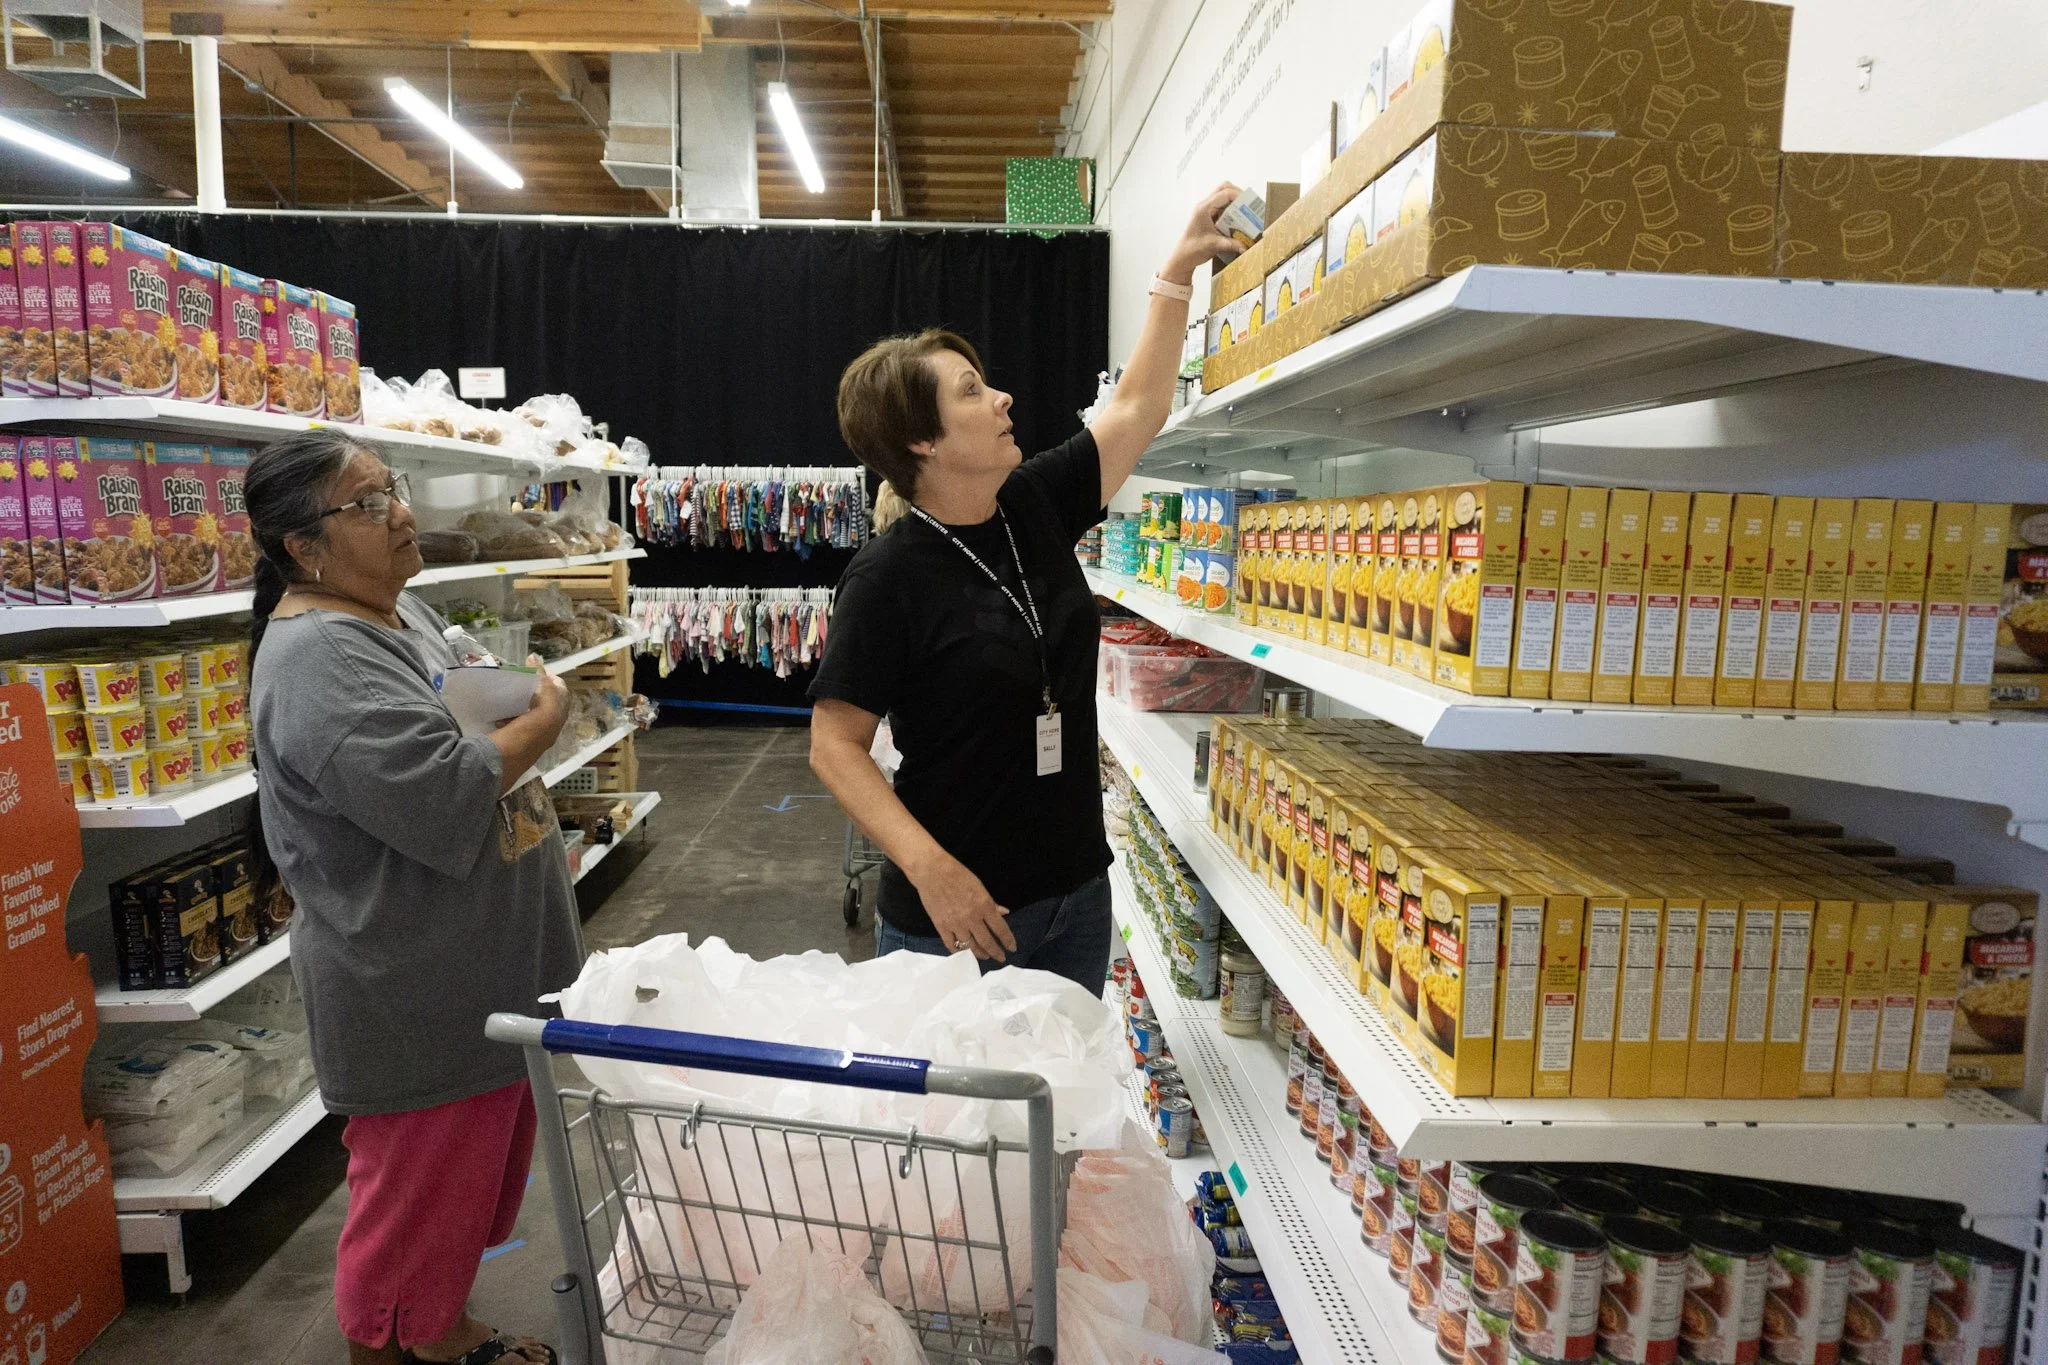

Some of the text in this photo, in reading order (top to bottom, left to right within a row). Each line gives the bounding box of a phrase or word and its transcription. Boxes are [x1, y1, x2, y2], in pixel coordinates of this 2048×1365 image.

[1237, 45, 1257, 87] God's
[1257, 15, 1272, 57] will
[1272, 1, 1285, 35] for
[129, 267, 168, 300] Raisin
[89, 296, 112, 304] BITE
[135, 289, 166, 315] Bran
[178, 286, 212, 316] Raisin
[181, 306, 208, 329] Bran
[234, 301, 260, 328] Raisin
[288, 314, 317, 339] Raisin
[237, 321, 260, 341] Bran
[293, 333, 317, 352] Bran
[330, 324, 355, 349] Raisin
[333, 342, 355, 361] Bran
[99, 476, 140, 499] Raisin
[164, 477, 205, 499] Raisin
[218, 479, 246, 499] Rais
[30, 508, 54, 516] BITE
[61, 509, 84, 517] BITE
[105, 495, 139, 517] Bran
[170, 496, 204, 516] Bran
[224, 497, 247, 515] Bra
[929, 519, 949, 535] CENTER
[951, 536, 998, 582] CITY HOPE CENTER
[1001, 585, 1038, 639] CITY HOPE CENTER
[1043, 744, 1056, 752] SALLY
[1, 860, 54, 892] Finish Your
[3, 884, 43, 912] Favorite
[6, 893, 60, 931] Bear Naked
[8, 921, 46, 950] Granola
[1432, 930, 1458, 952] MACARONI
[1439, 945, 1459, 963] CHEESE
[17, 996, 75, 1042] Find Nearest
[20, 1010, 83, 1061] Store Drop-off
[32, 1134, 68, 1170] Deposit
[34, 1138, 89, 1188] Clean Pouch
[36, 1153, 96, 1207] in Recycle Bin
[38, 1164, 105, 1225] for Plastic Bags
